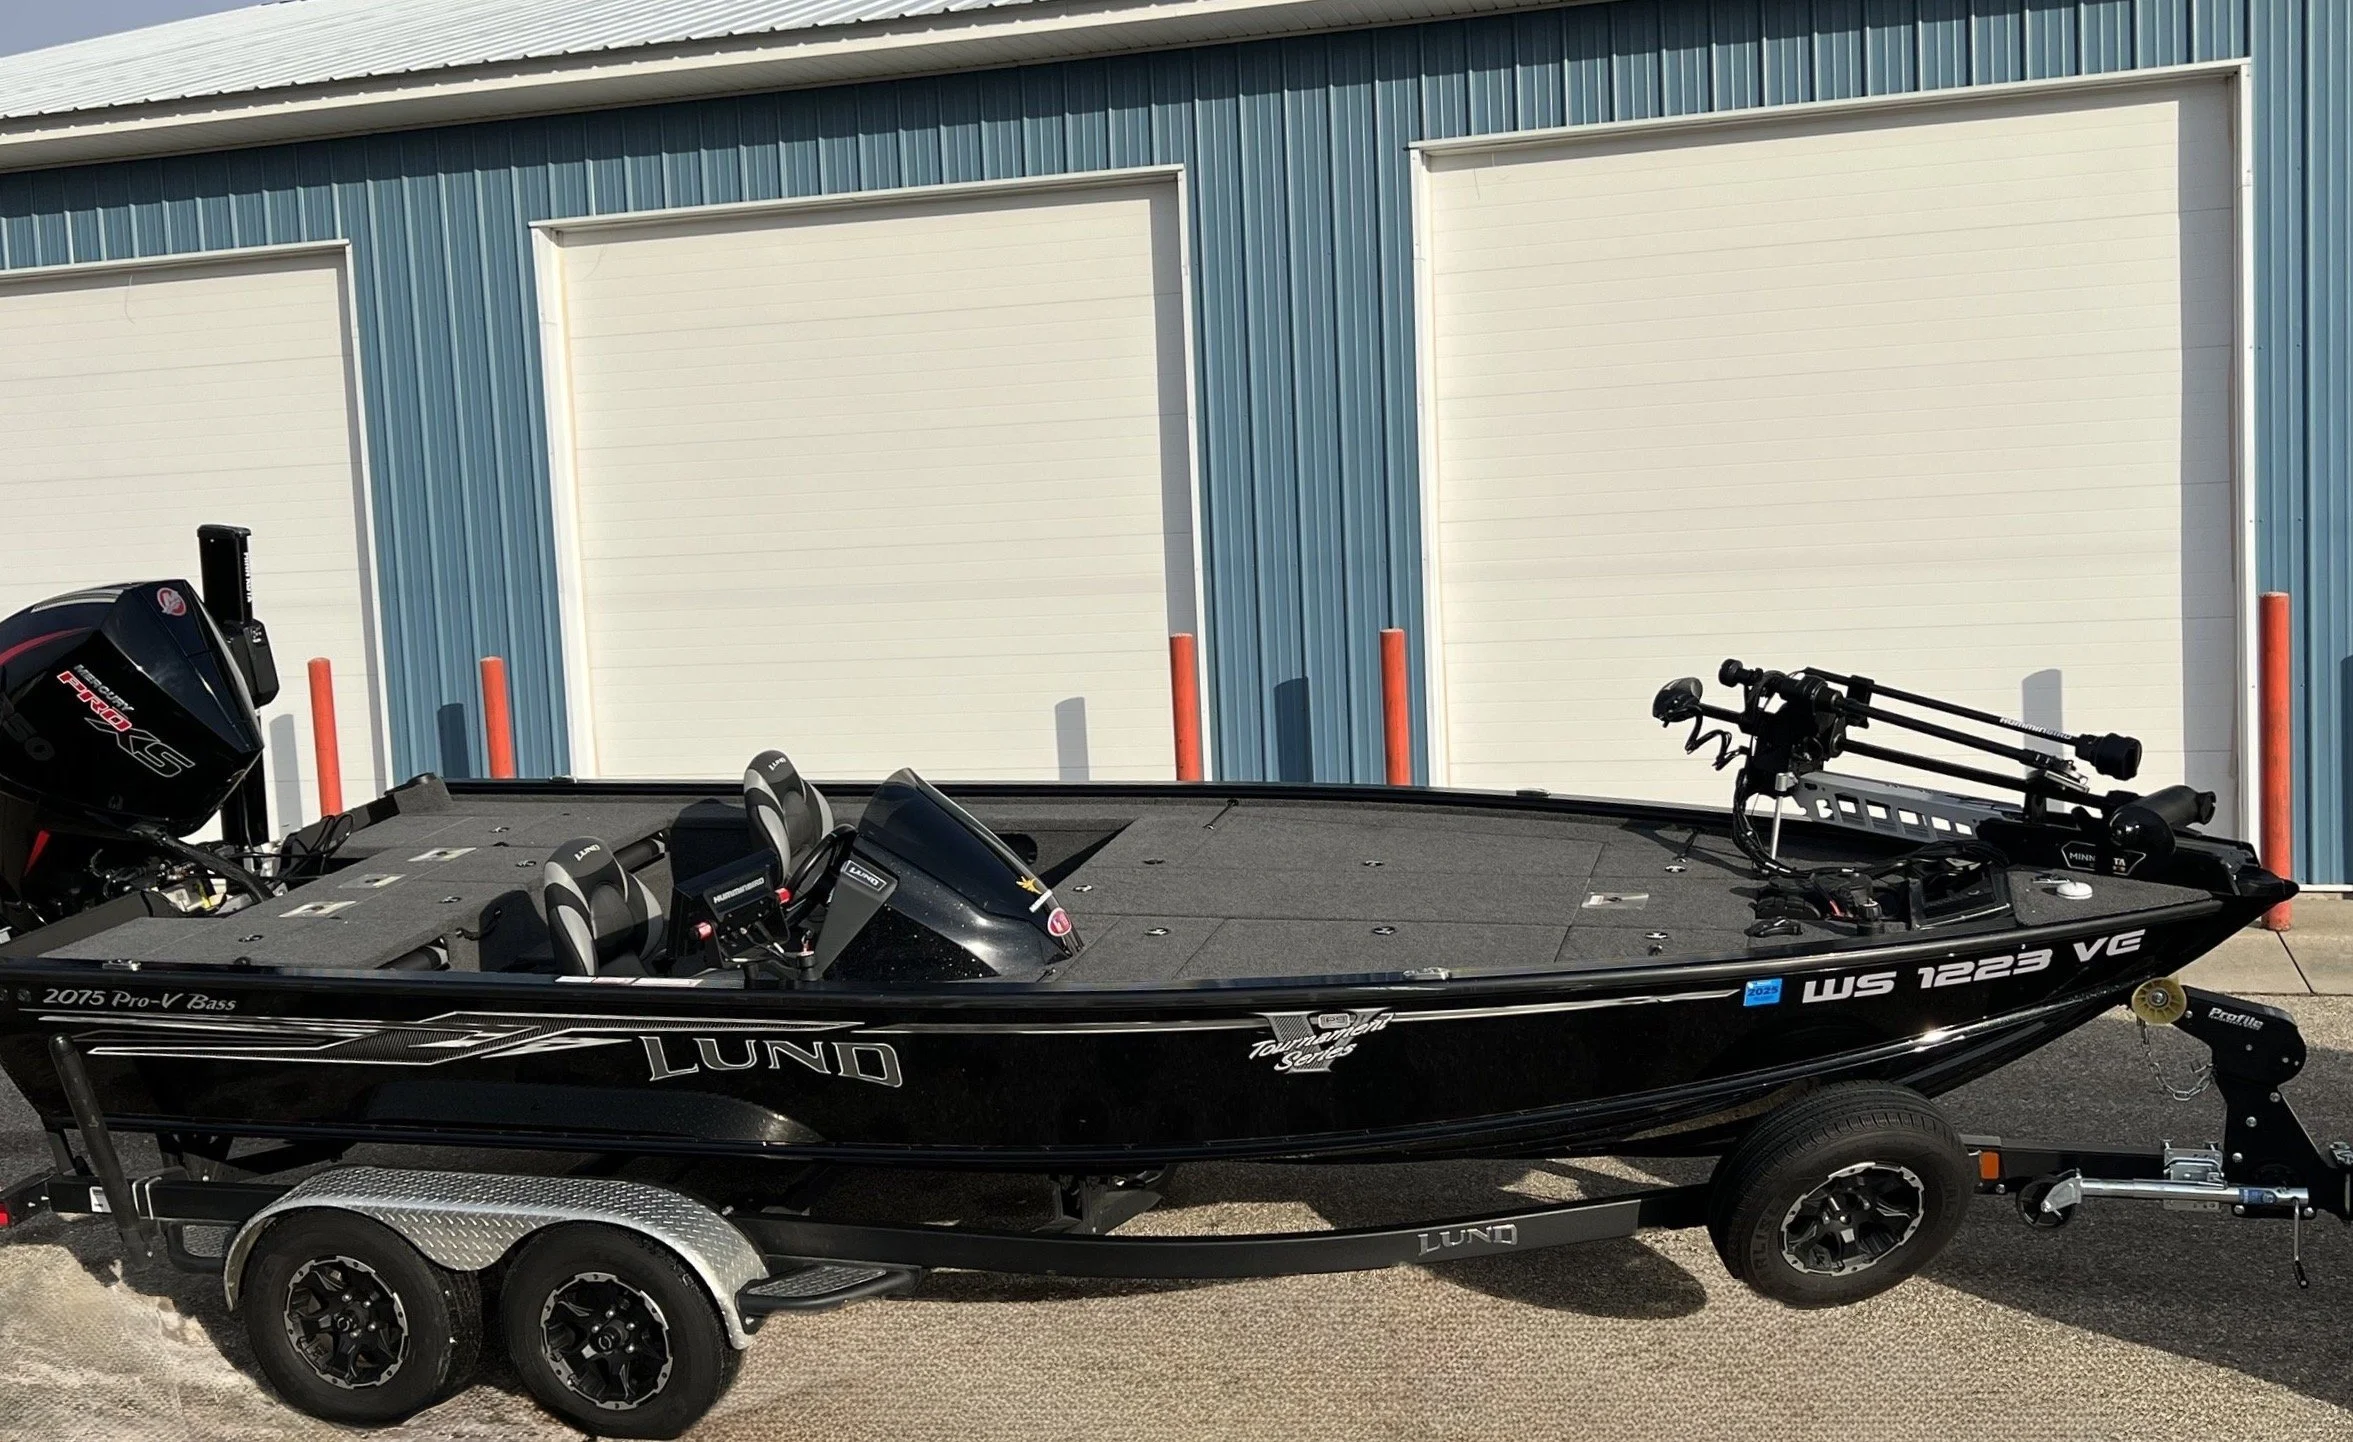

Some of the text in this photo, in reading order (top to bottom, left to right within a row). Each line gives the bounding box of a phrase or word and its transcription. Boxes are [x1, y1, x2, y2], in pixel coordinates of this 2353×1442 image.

[56, 670, 132, 732] PRO
[73, 664, 134, 711] MERCURY
[84, 717, 196, 777] XS
[574, 844, 600, 861] LUND
[713, 877, 765, 904] HUMMINBIRD
[849, 866, 880, 886] LUND
[1801, 929, 2147, 1004] WS 1223 VE
[43, 988, 237, 1011] 2075 Pro-V Bass
[1747, 985, 1779, 997] 2025
[2208, 1007, 2264, 1028] Profile
[1248, 1012, 1395, 1060] Tournament
[638, 1036, 903, 1088] LUND
[1273, 1043, 1358, 1071] Series
[1418, 1224, 1517, 1257] LUND
